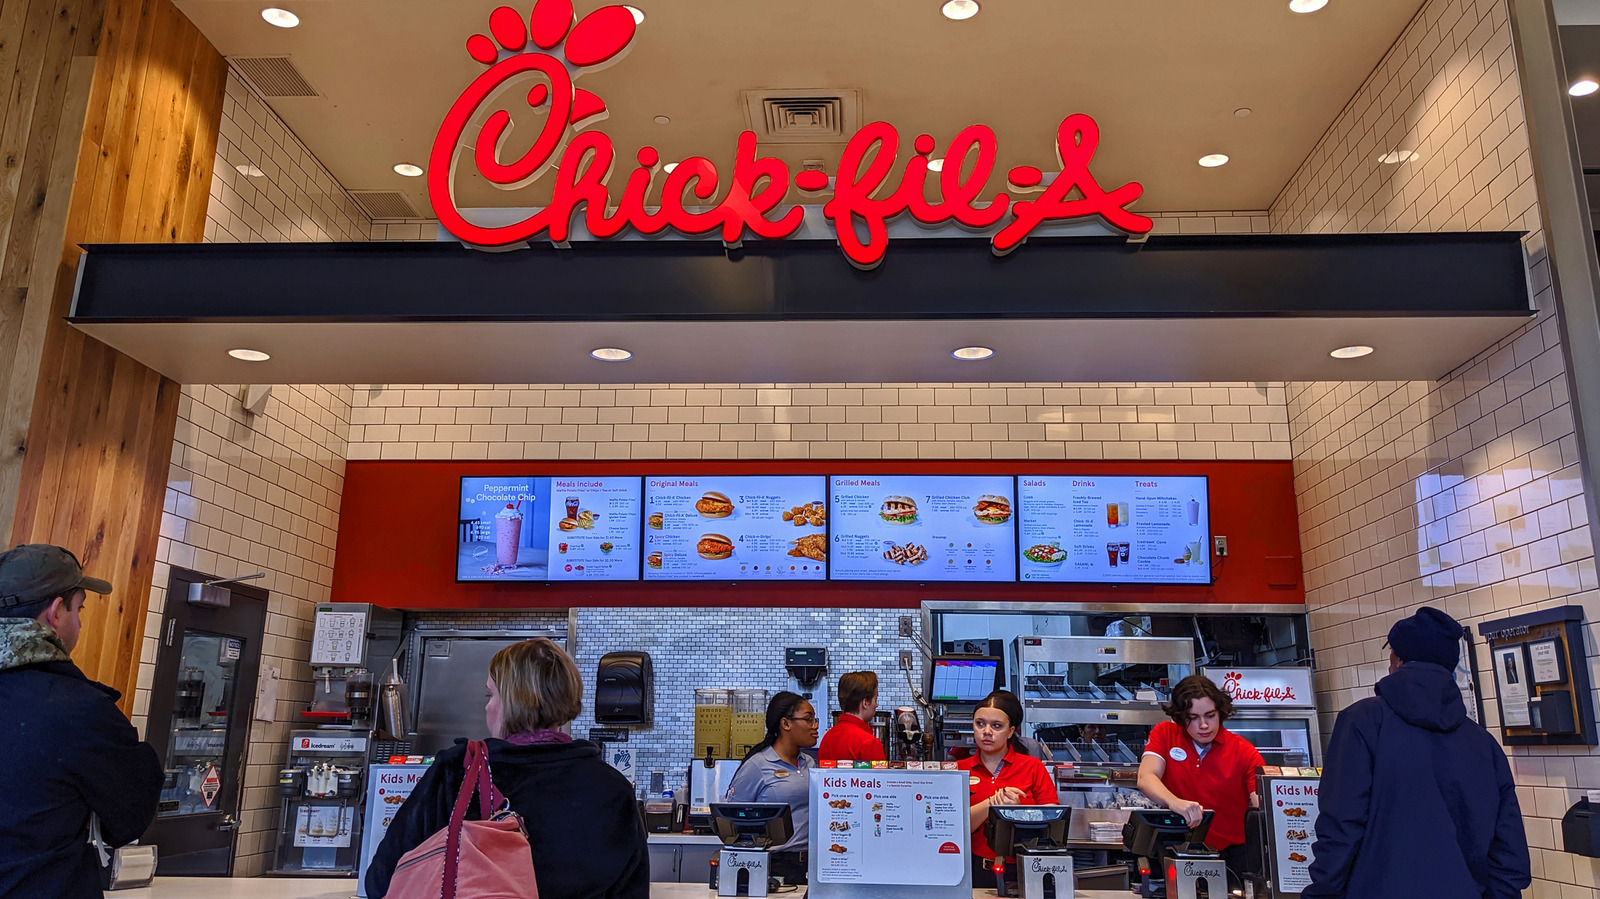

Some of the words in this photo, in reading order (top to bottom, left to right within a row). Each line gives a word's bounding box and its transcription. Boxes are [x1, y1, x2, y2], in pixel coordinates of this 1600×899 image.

[428, 40, 1154, 266] Chick-fil-A
[484, 484, 529, 493] Peppermint
[517, 494, 536, 502] Chip
[649, 496, 655, 504] 1
[739, 496, 745, 504] 3
[834, 495, 840, 503] 5
[925, 496, 931, 504] 7
[649, 535, 654, 543] 2
[834, 535, 840, 543] 6
[1501, 625, 1529, 640] operator
[1223, 678, 1296, 703] Chick-fil-A
[380, 774, 403, 783] Kids
[823, 777, 847, 788] Kids
[850, 777, 881, 788] Meals
[1275, 785, 1300, 795] Kids
